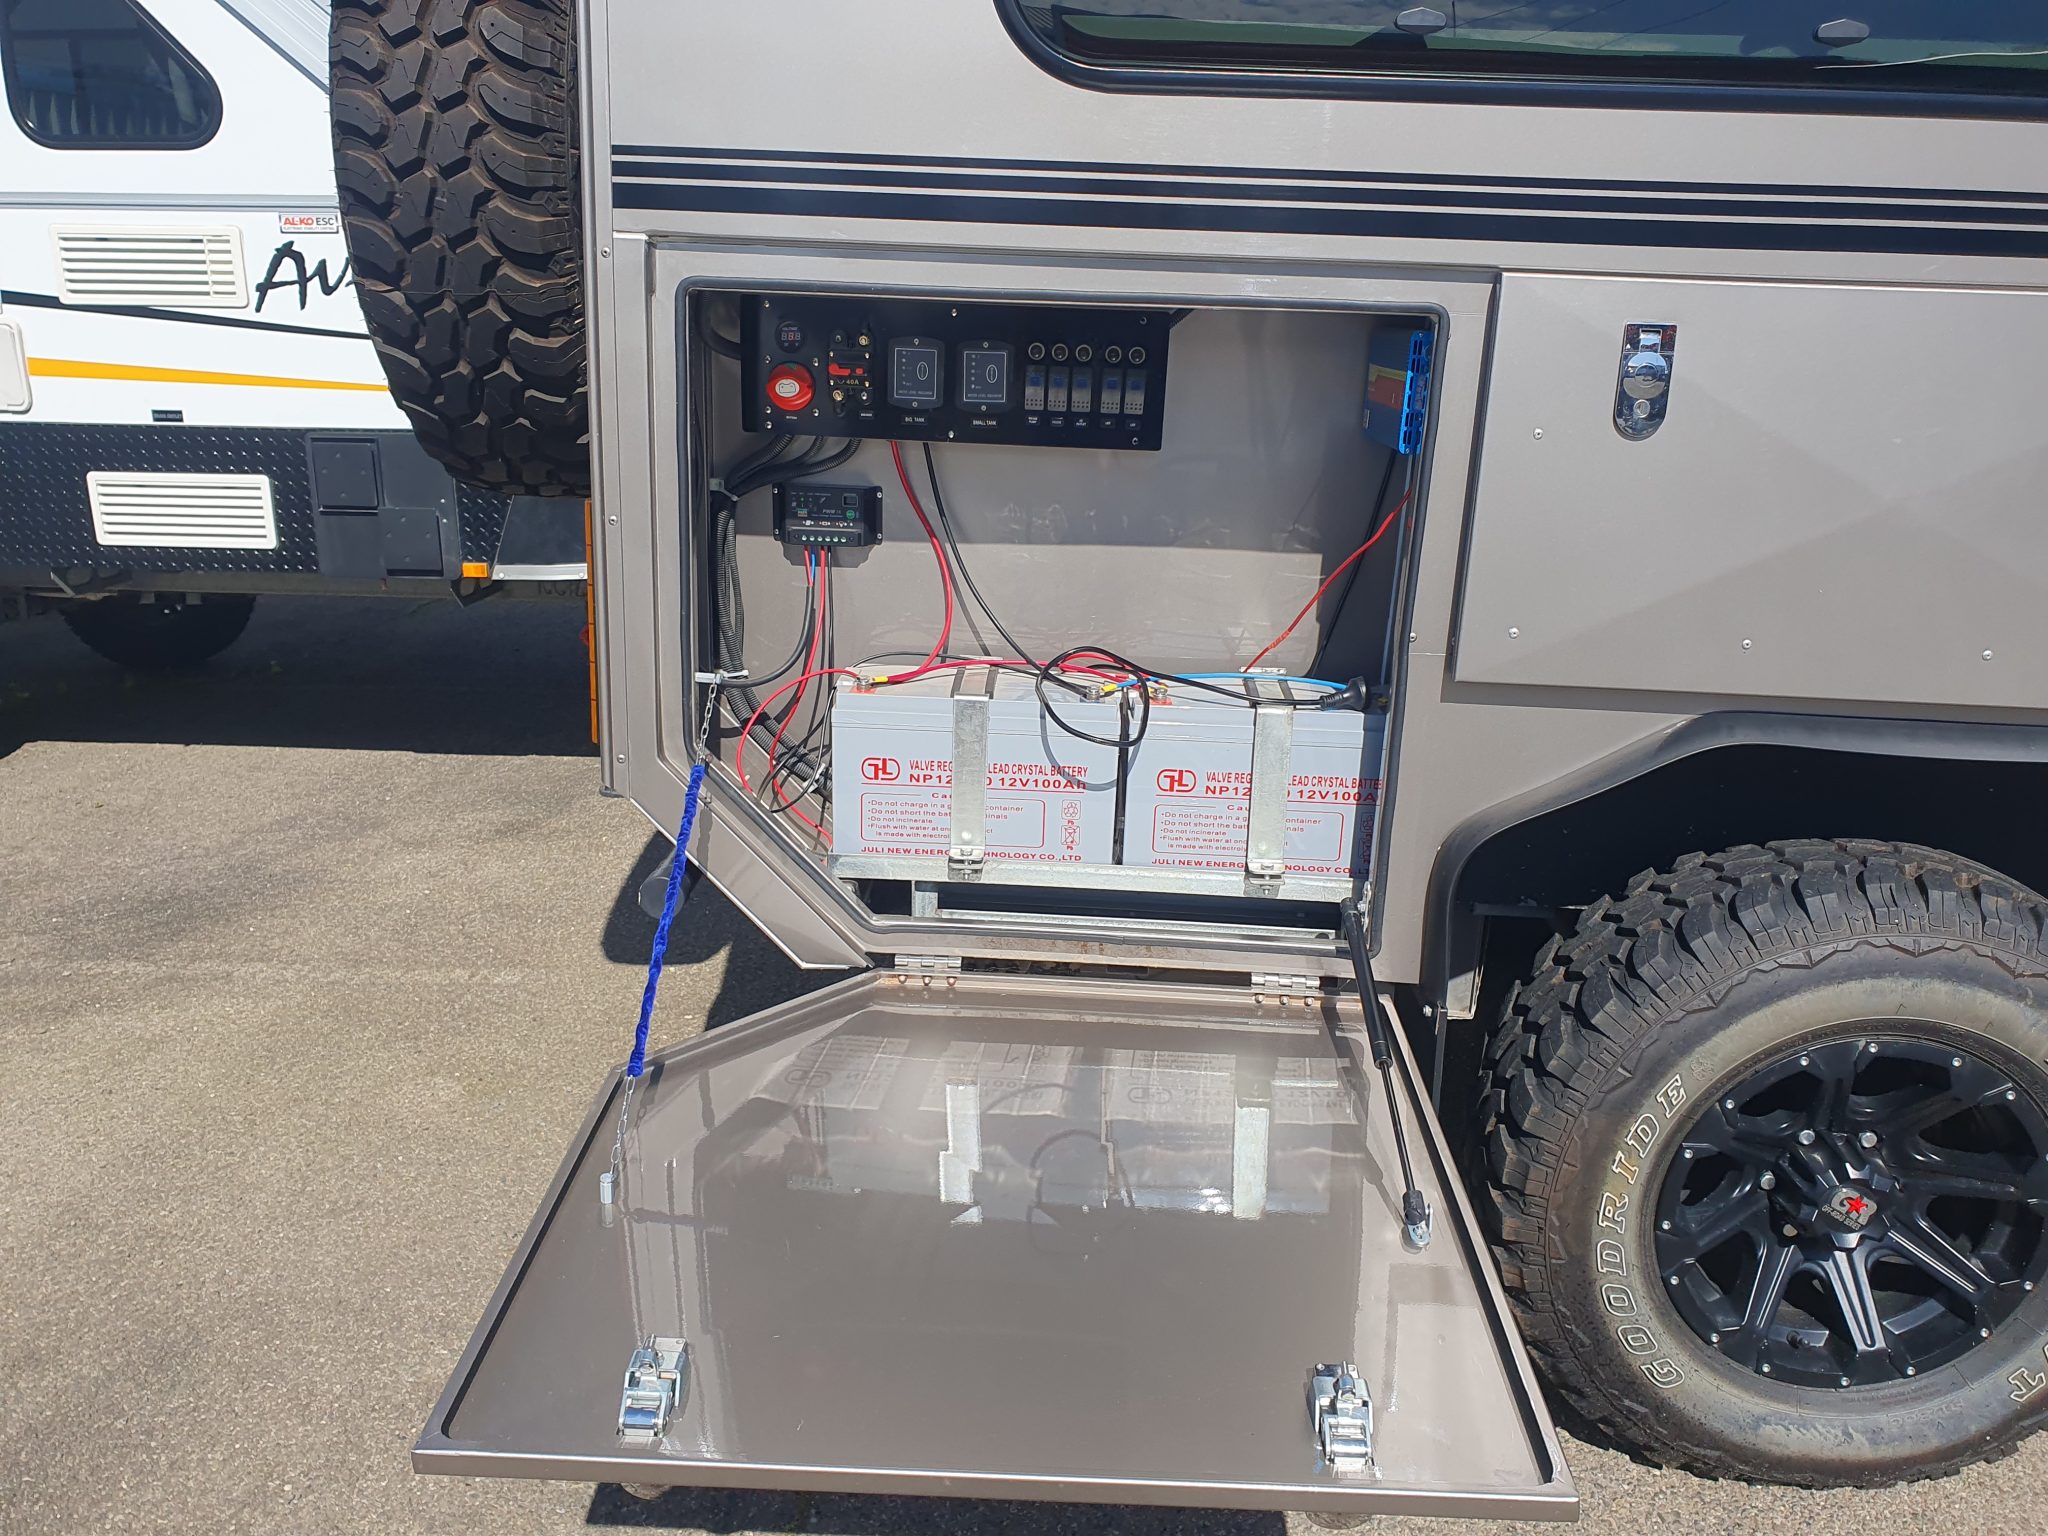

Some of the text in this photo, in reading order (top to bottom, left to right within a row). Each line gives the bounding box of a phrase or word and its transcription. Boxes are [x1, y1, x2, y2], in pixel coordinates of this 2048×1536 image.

[283, 217, 335, 226] AL-KO ESC
[255, 240, 354, 313] Av
[909, 760, 935, 771] VALVE
[988, 763, 1010, 774] LEAD
[1012, 764, 1048, 776] CRYSTAL
[1051, 765, 1088, 778] BATTERY
[999, 777, 1087, 790] 12V100Ah
[1206, 772, 1232, 783] VALVE
[1311, 776, 1349, 789] CRYSTAL
[1297, 789, 1377, 802] 12V100A
[984, 852, 1036, 860] HNOLOGY
[1206, 860, 1244, 869] ENERG
[1284, 864, 1332, 873] NOLOGY
[1597, 1074, 1687, 1389] GOODRIDE
